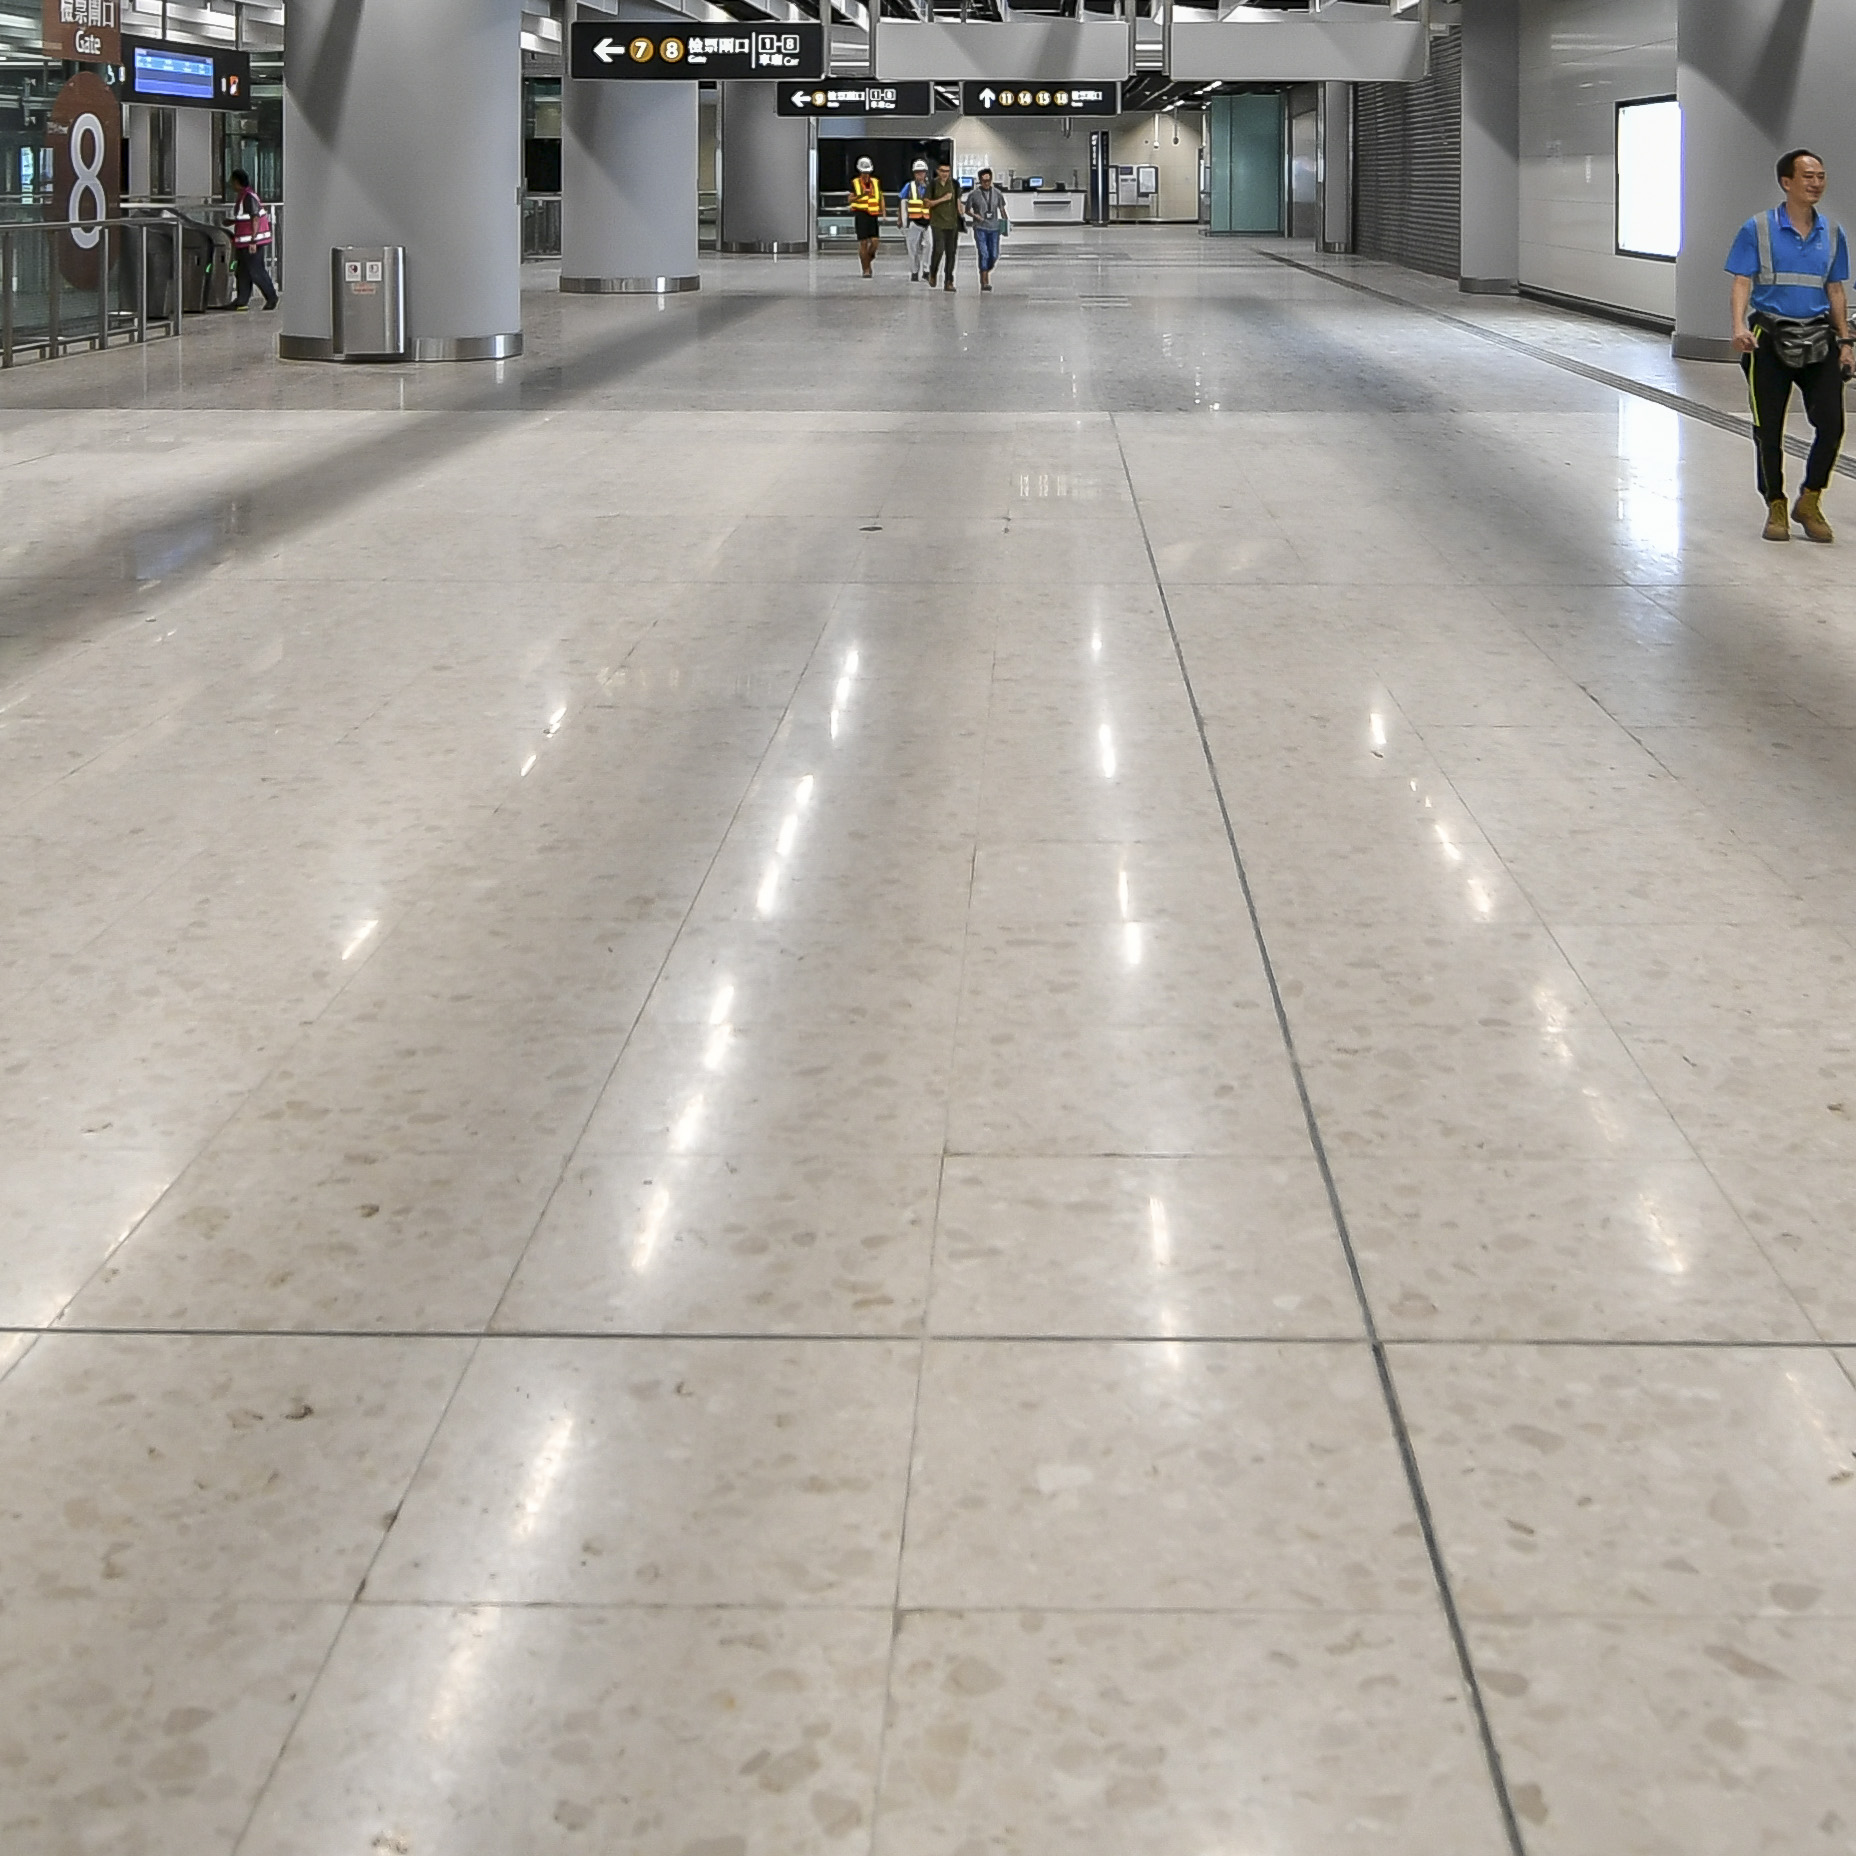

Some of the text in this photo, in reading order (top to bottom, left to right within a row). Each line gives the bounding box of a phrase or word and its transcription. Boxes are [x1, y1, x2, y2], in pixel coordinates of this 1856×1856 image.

[75, 30, 101, 54] Gate
[635, 41, 649, 58] 7
[665, 41, 679, 58] 8
[69, 113, 106, 249] 8
